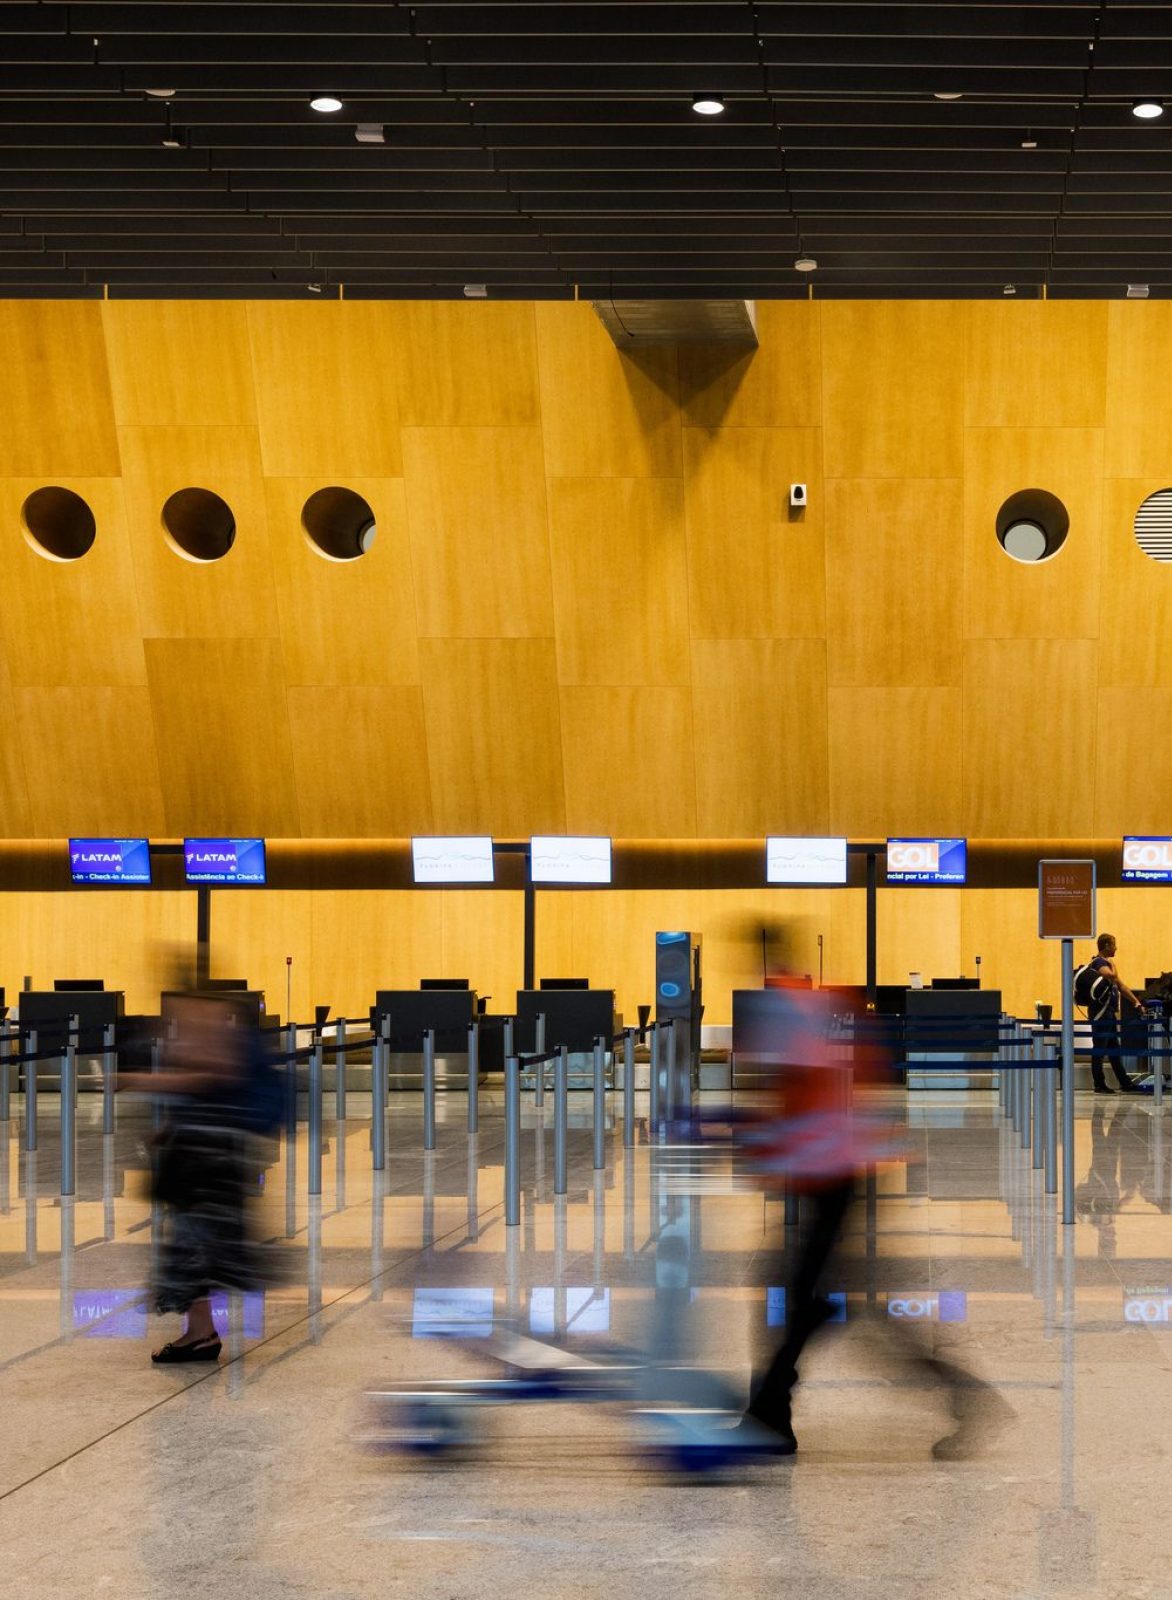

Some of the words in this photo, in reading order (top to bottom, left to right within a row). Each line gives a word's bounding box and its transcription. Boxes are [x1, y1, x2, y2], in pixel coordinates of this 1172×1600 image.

[81, 853, 122, 863] LATAM
[196, 853, 237, 863] LATAM
[891, 846, 938, 868] GOL
[1124, 845, 1171, 867] GOL
[1136, 872, 1168, 880] Bagagem
